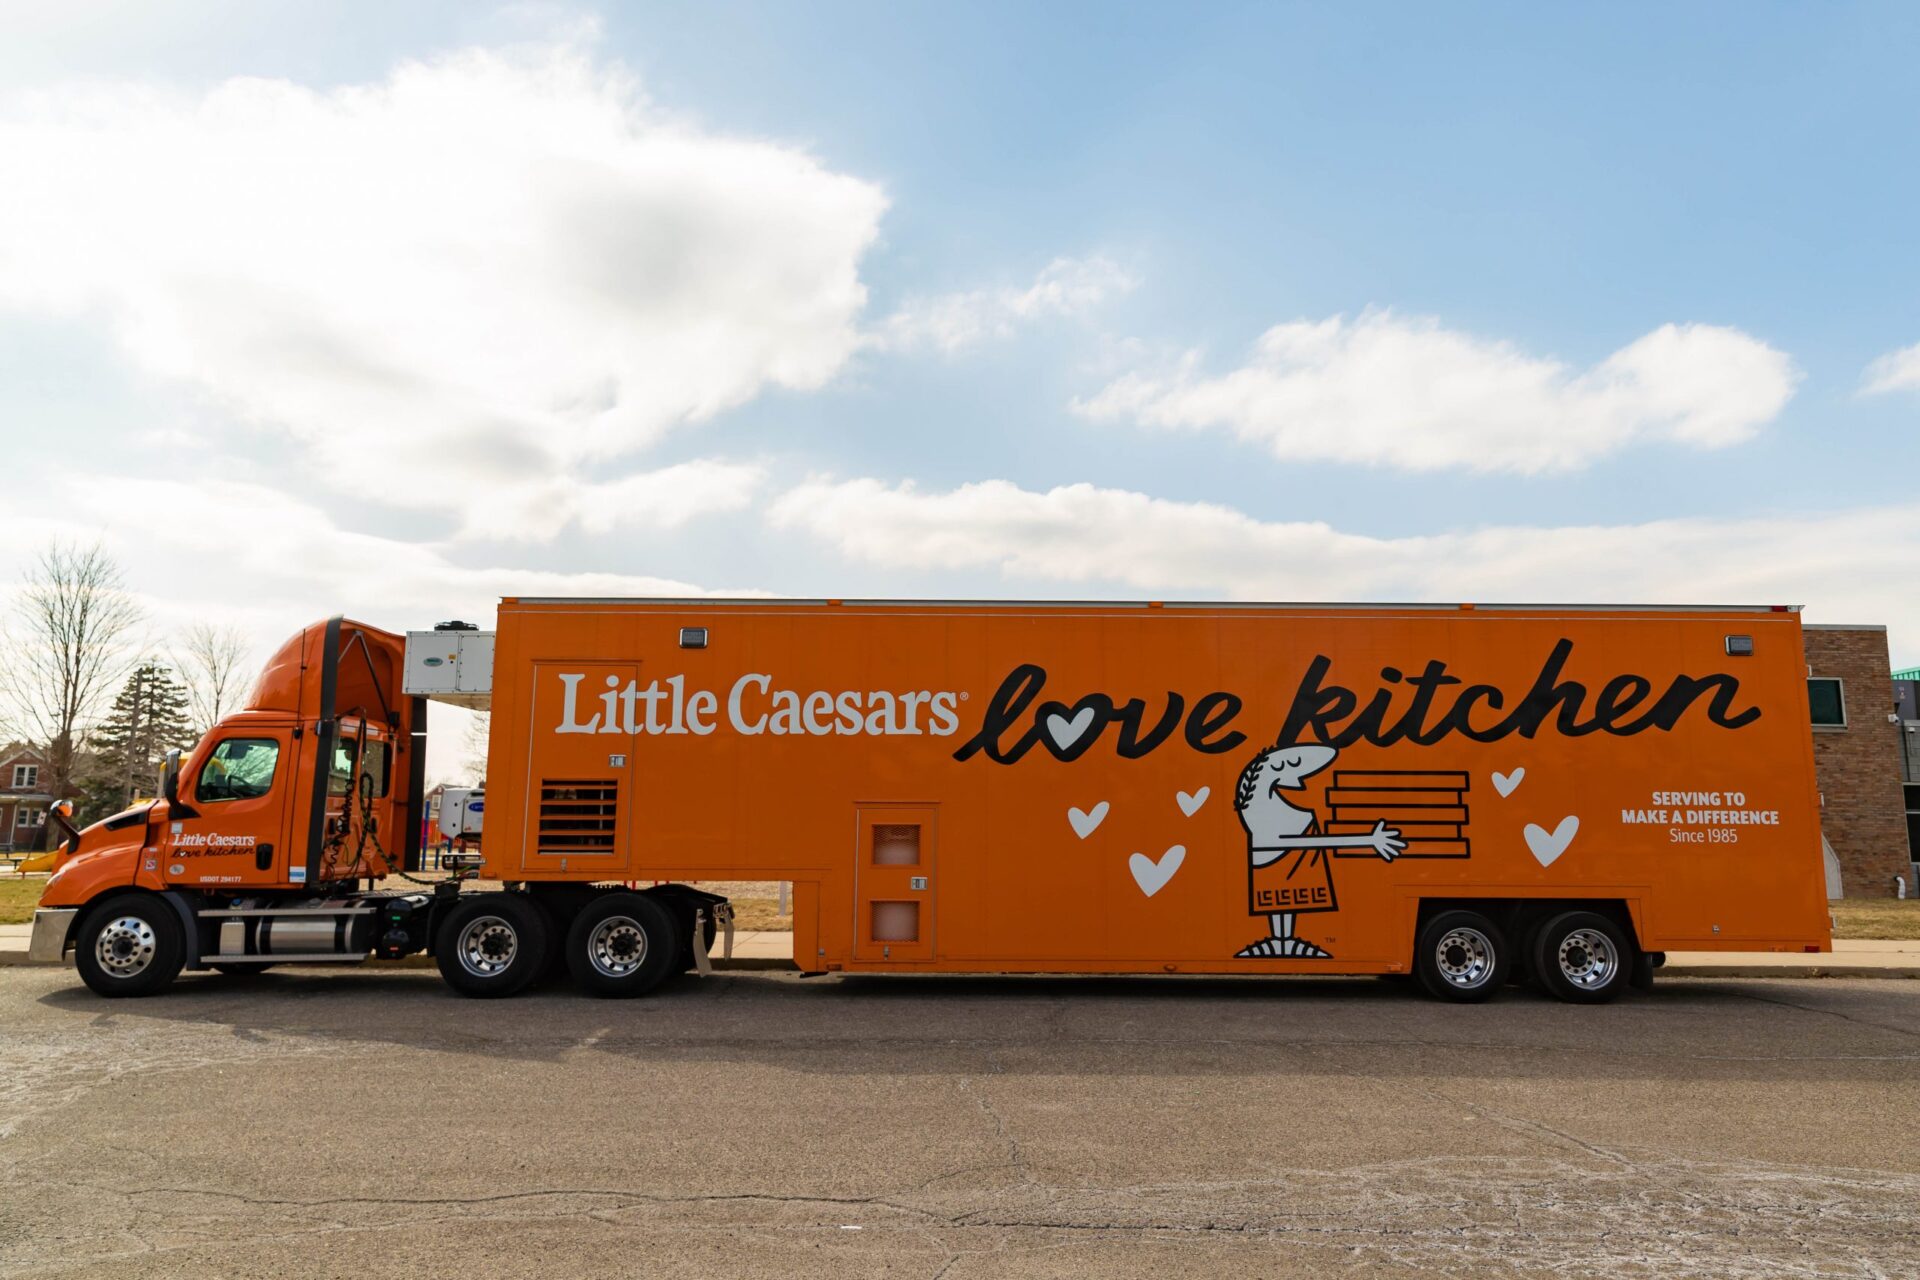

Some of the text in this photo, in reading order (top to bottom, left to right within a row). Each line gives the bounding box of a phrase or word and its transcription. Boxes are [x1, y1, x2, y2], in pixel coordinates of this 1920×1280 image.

[556, 674, 718, 735] Little
[952, 638, 1762, 766] love kitchen
[1652, 791, 1746, 806] SERVING TO
[1622, 809, 1779, 825] MAKE A DIFFERENCE
[173, 832, 255, 846] Little Caesars
[1669, 828, 1738, 843] Since 1985
[204, 847, 255, 858] kitchen
[199, 875, 219, 883] USDOT
